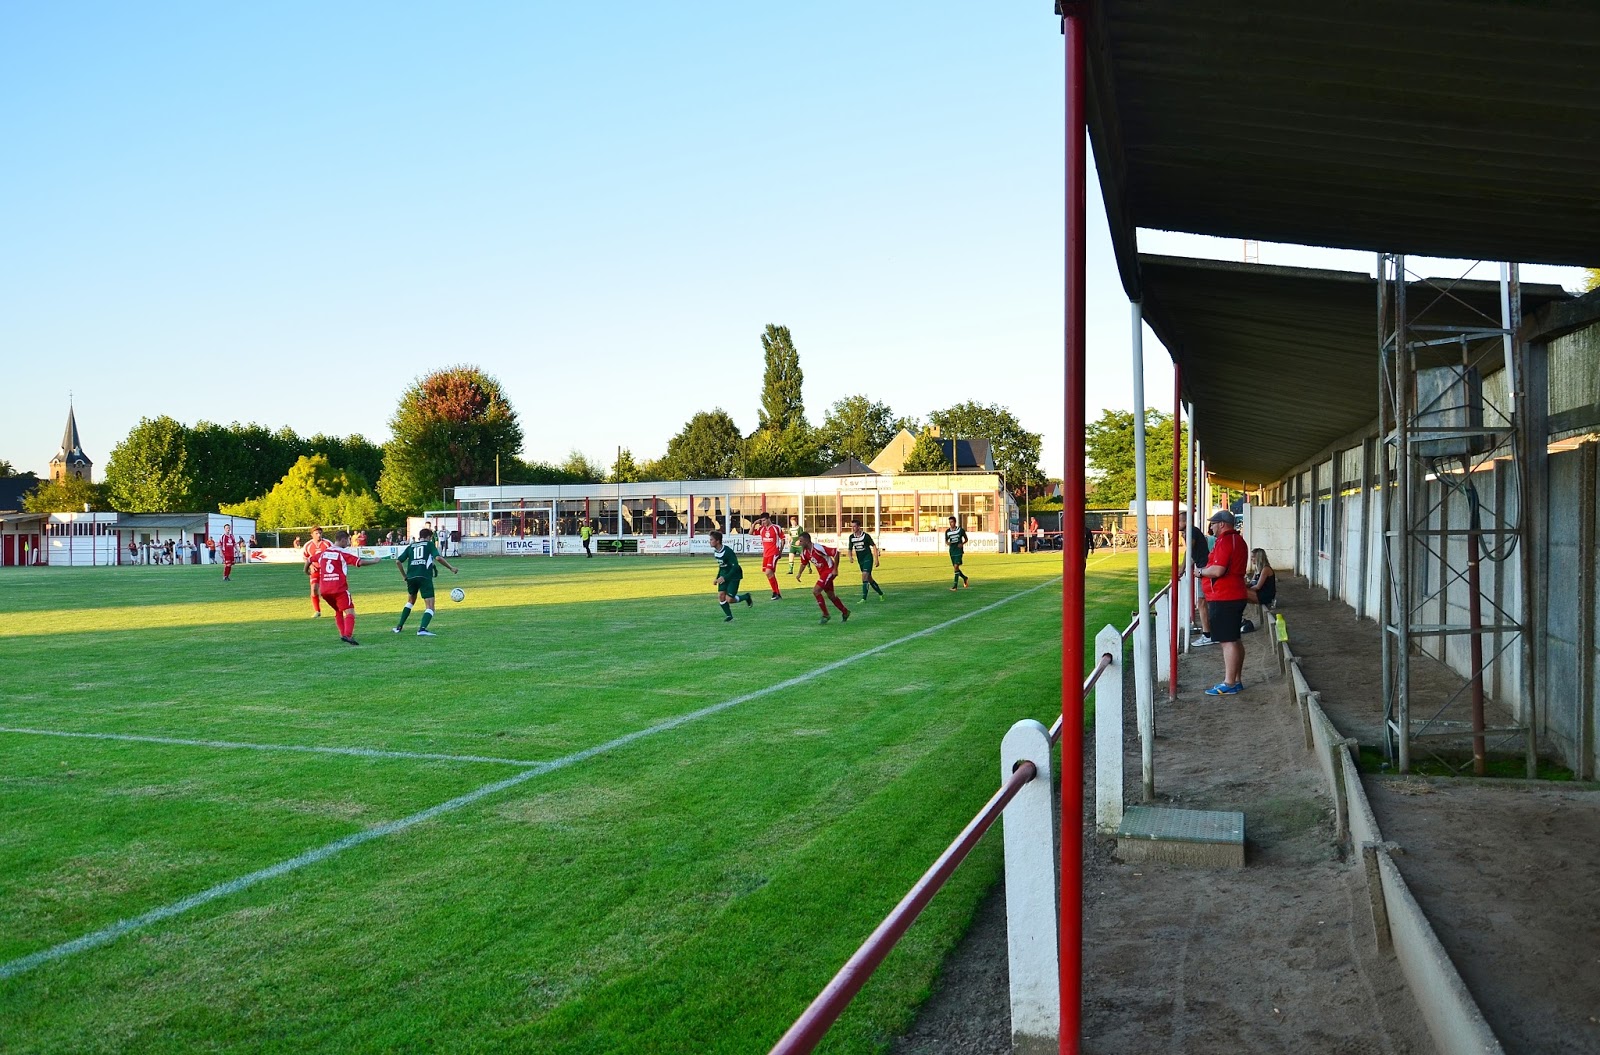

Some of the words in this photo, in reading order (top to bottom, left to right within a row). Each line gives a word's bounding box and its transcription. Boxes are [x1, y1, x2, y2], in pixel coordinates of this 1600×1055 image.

[506, 541, 533, 549] MEVAC
[662, 539, 689, 548] Lieve
[412, 546, 424, 559] 10
[325, 559, 335, 573] 6
